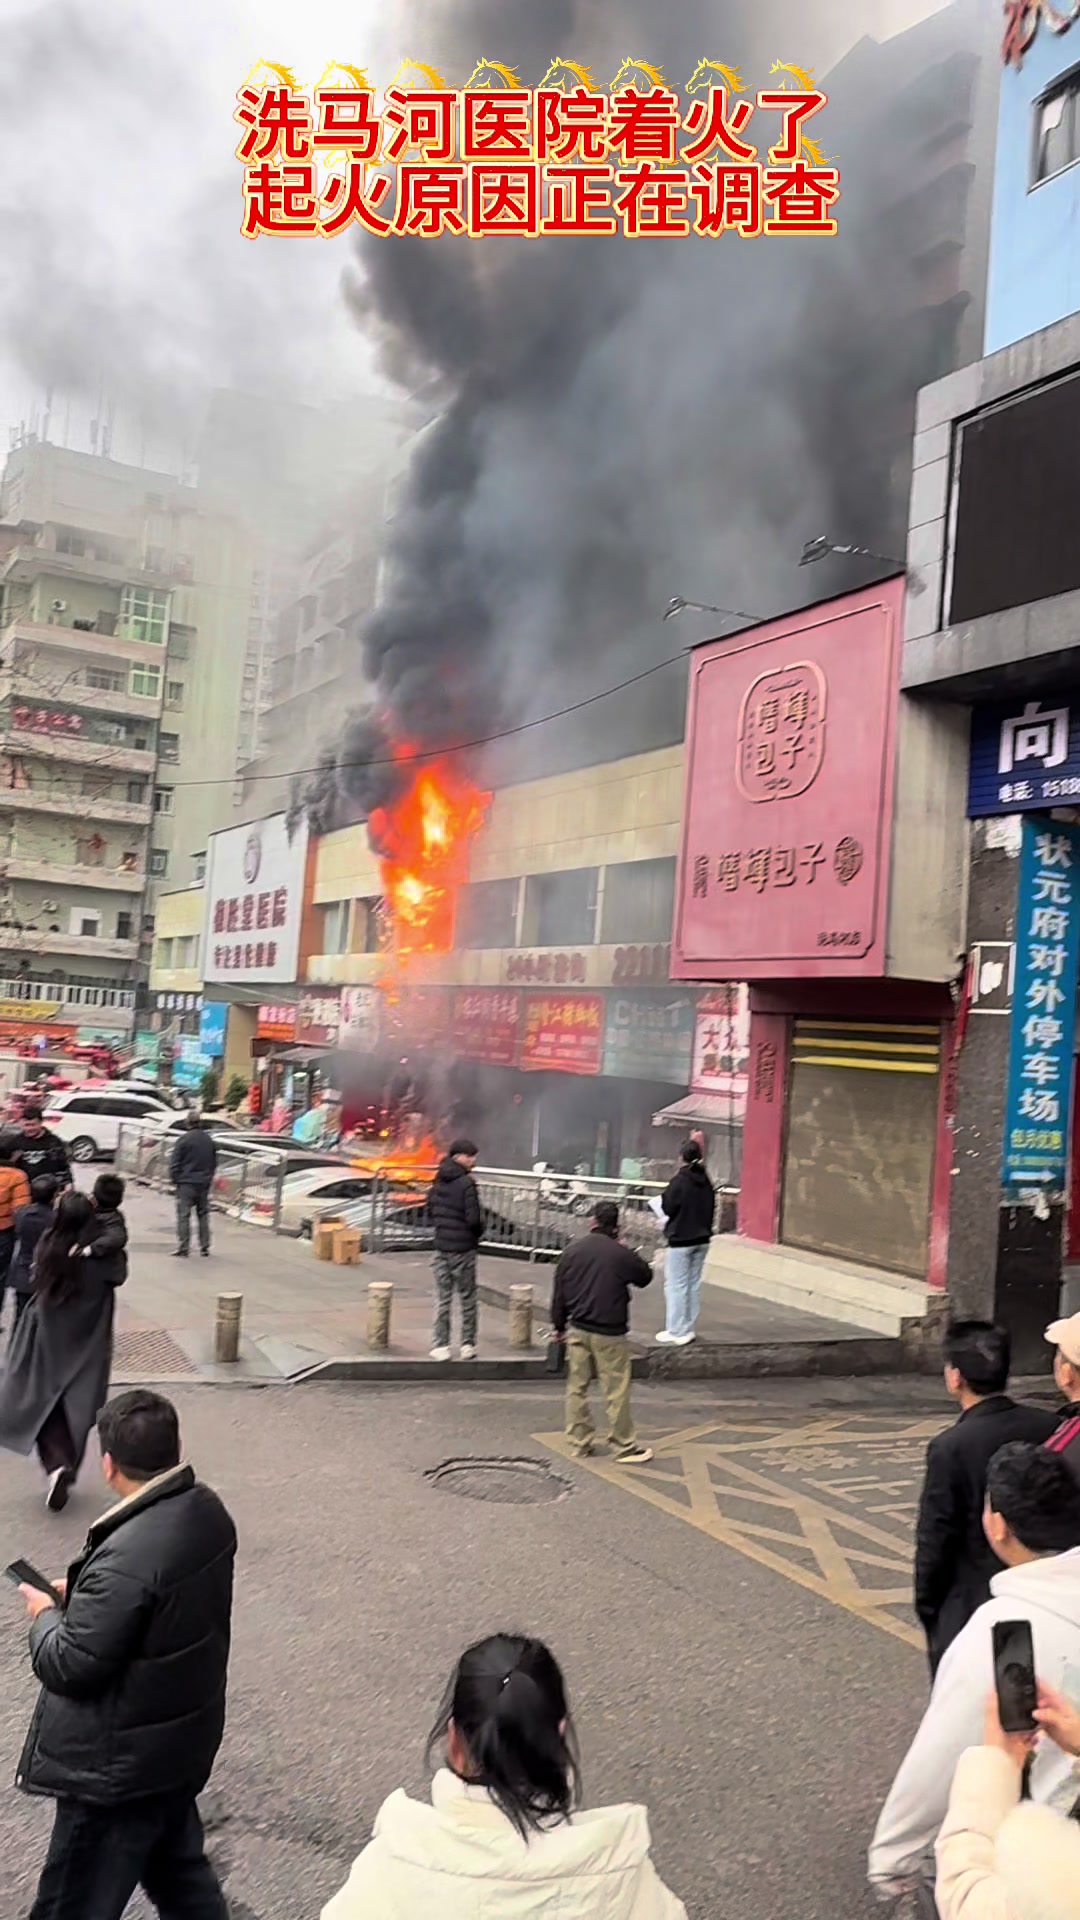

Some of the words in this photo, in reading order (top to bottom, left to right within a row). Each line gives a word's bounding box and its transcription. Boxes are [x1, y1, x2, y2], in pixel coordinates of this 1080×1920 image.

[998, 702, 1070, 774] 向
[1017, 832, 1073, 1123] 状元府对外停车场
